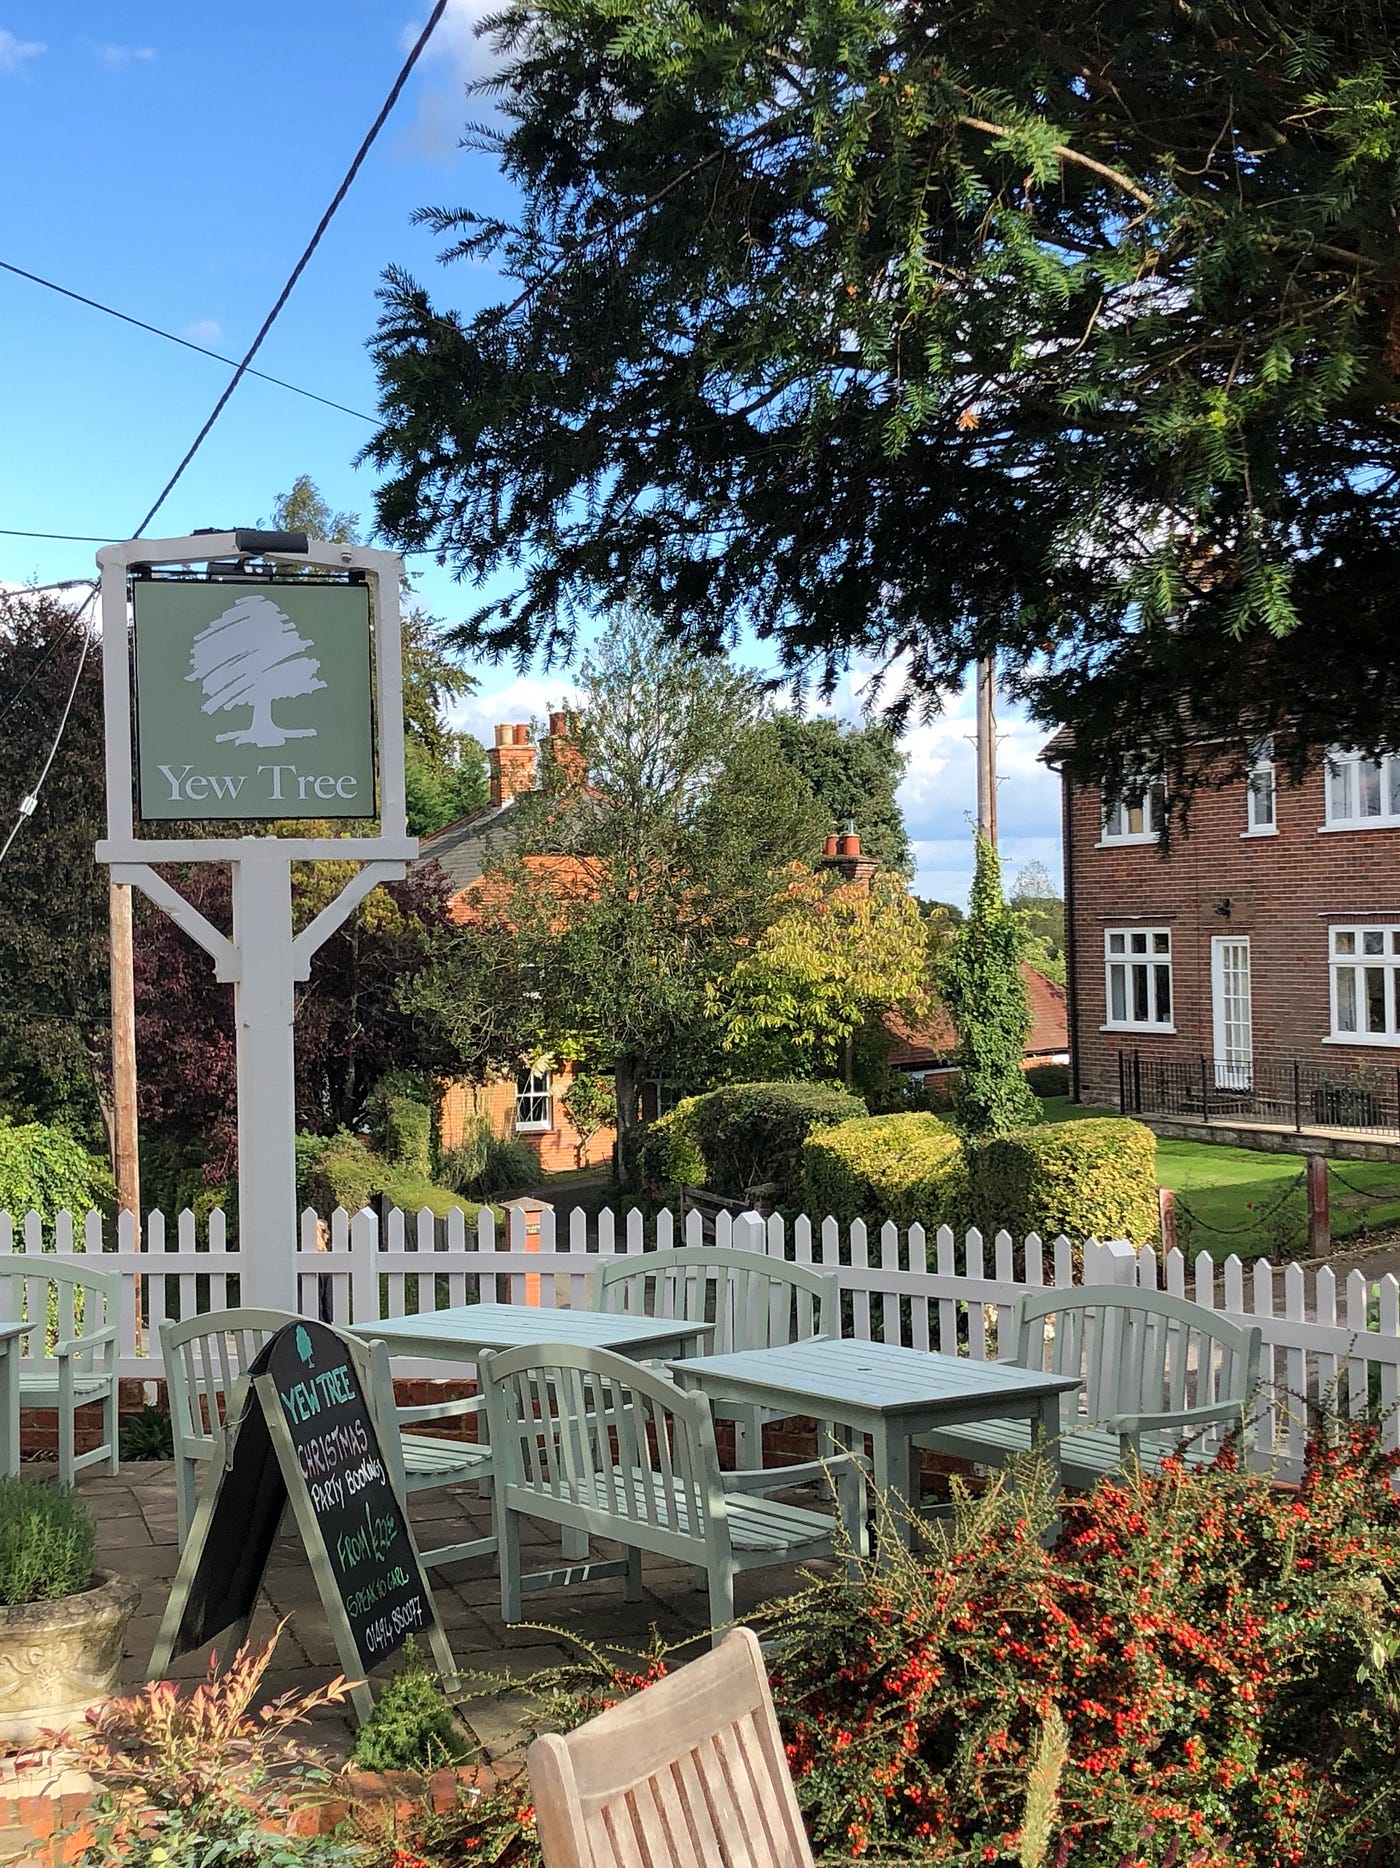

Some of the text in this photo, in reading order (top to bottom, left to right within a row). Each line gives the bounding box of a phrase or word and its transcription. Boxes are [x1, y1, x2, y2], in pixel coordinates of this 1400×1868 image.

[156, 765, 358, 800] Yew Tree
[281, 1365, 356, 1424] YEW TREE
[298, 1419, 368, 1479] CHRISTMAS
[311, 1473, 345, 1512] PARTY
[337, 1527, 371, 1573] FROM
[346, 1566, 410, 1618] SPEAK TO CARL
[366, 1616, 394, 1653] 01494
